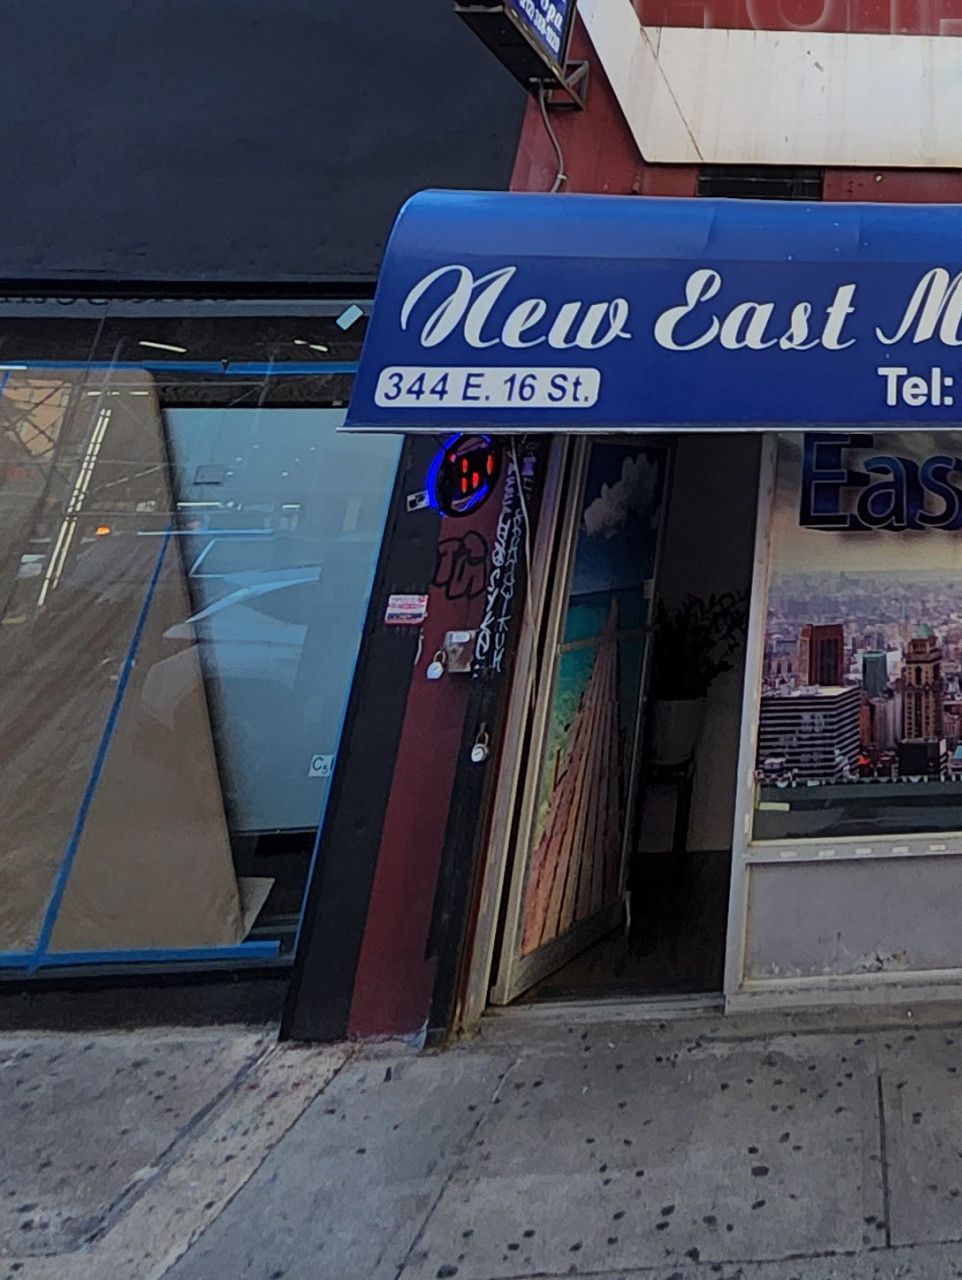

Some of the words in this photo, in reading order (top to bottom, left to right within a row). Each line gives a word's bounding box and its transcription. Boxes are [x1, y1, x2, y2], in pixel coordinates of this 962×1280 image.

[401, 264, 632, 348] New
[654, 268, 856, 351] East
[384, 372, 449, 402] 344
[462, 372, 490, 402] E.
[503, 373, 536, 402] 16
[547, 372, 590, 403] St.
[877, 366, 954, 406] Tel:
